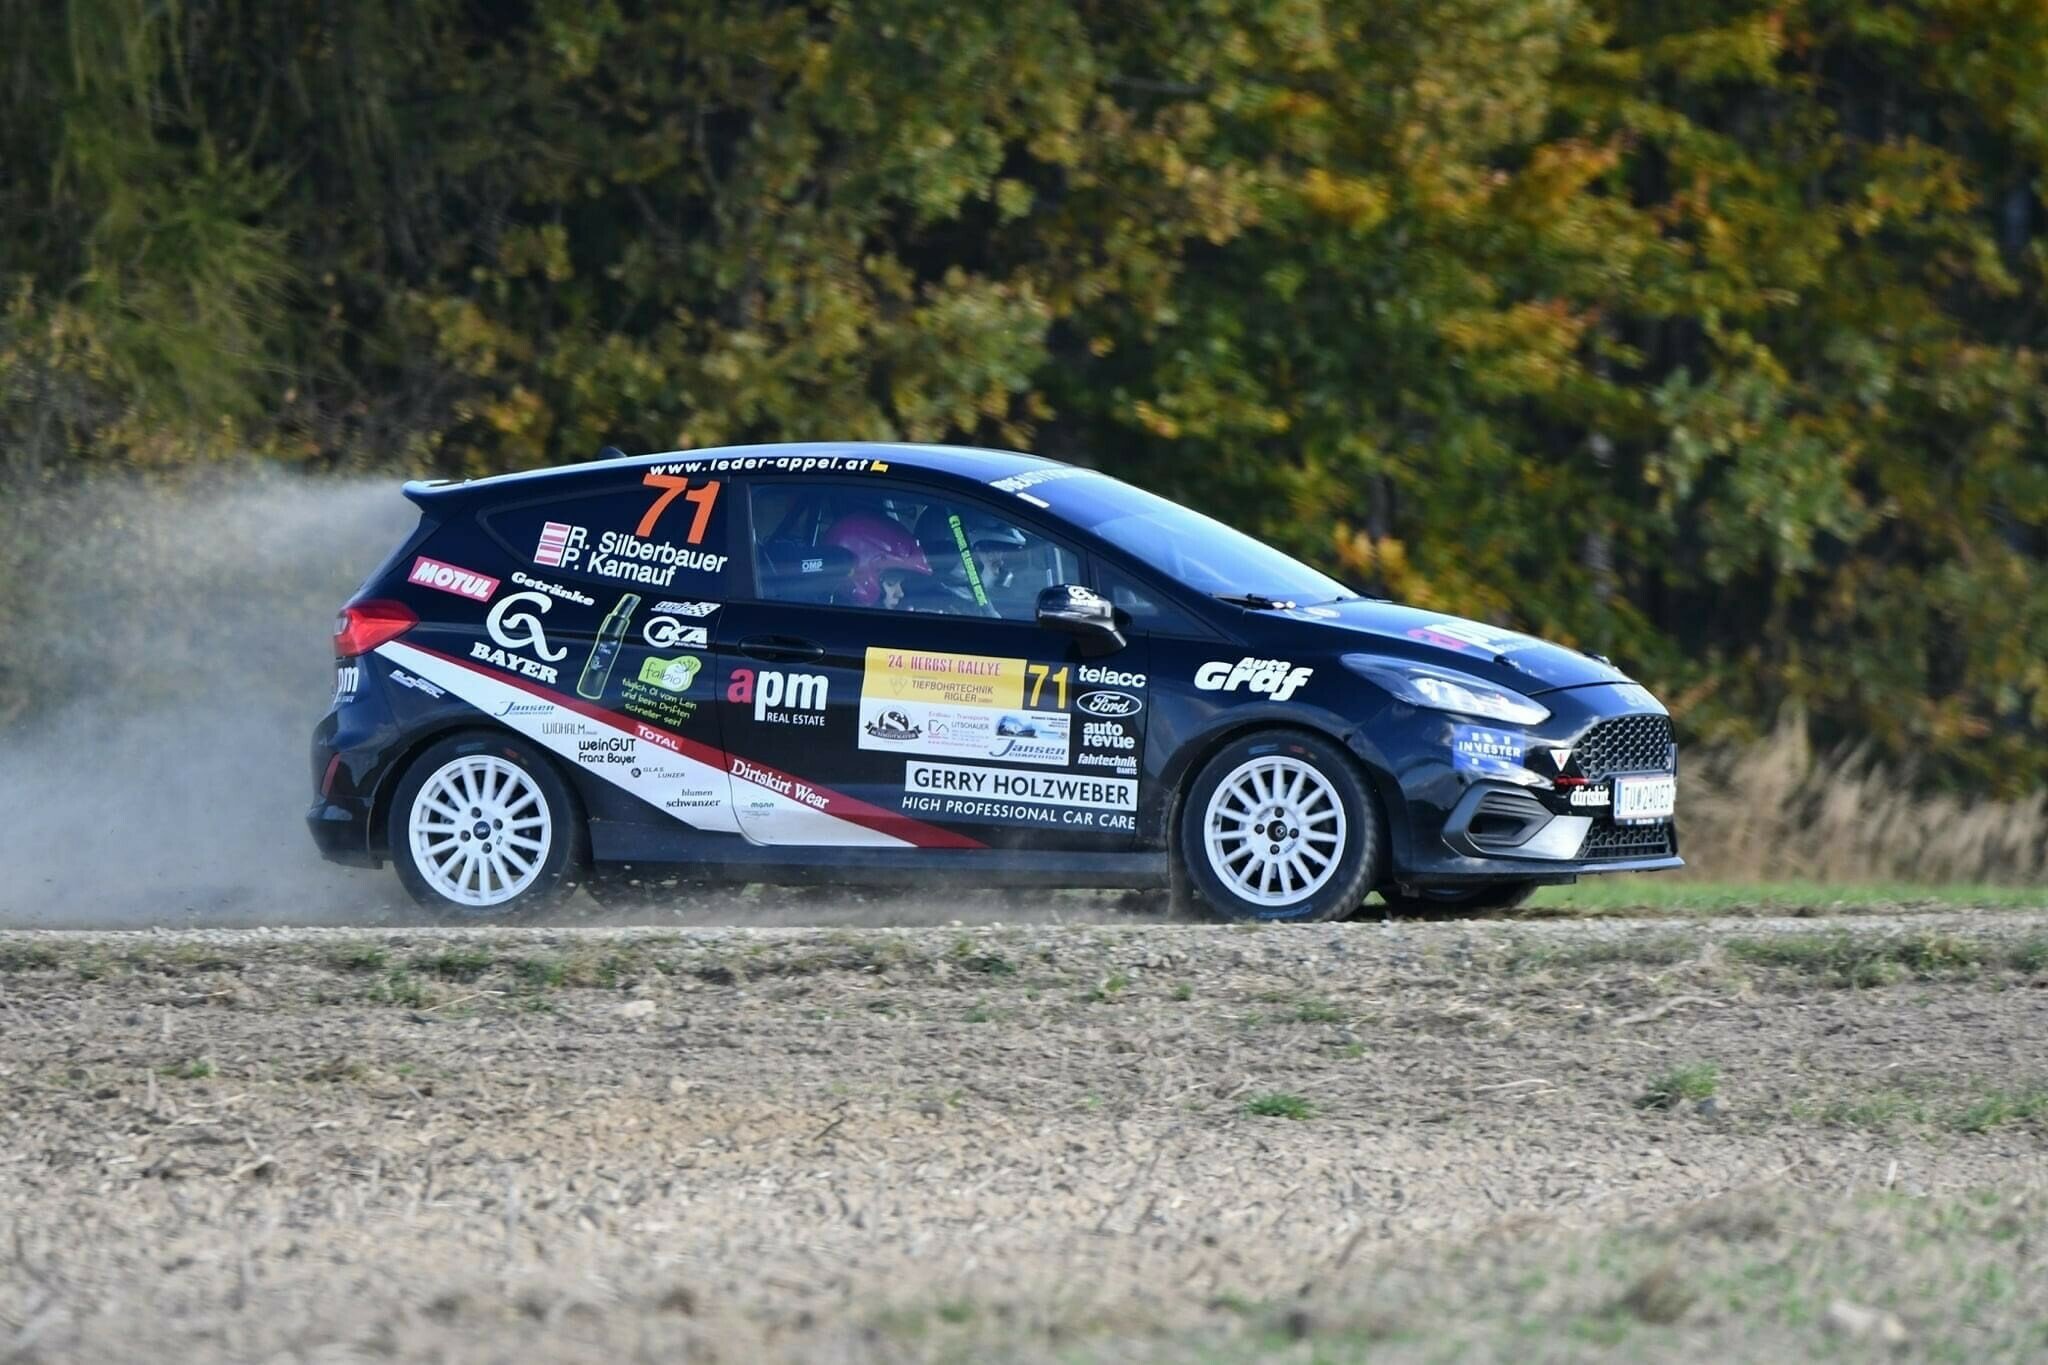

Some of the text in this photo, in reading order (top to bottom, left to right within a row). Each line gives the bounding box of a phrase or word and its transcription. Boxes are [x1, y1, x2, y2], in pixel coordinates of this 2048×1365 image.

[650, 457, 868, 475] www.leder-appel.at
[635, 473, 720, 544] 71
[560, 547, 580, 571] P.
[567, 526, 728, 573] R. Silberbauer
[802, 561, 823, 570] OMP
[413, 562, 491, 597] MOTUL
[511, 572, 595, 606] Getränke
[470, 642, 558, 684] BAYER
[911, 656, 953, 673] HERBST
[958, 660, 1001, 677] RALLYE
[336, 667, 359, 695] pm
[1028, 664, 1069, 709] 71
[1078, 665, 1147, 688] telacc
[1194, 661, 1314, 701] Graf
[727, 668, 829, 721] apm
[912, 679, 994, 695] TIEFBOHRTECHNIK
[621, 691, 637, 700] und
[659, 702, 690, 718] Driften
[944, 692, 977, 703] RIGLER
[1089, 694, 1130, 713] Ford
[494, 701, 554, 716] Jansen
[767, 711, 825, 726] REAL ESTATE
[542, 722, 586, 735] WIDHALM
[636, 724, 679, 750] TOTAL
[1083, 721, 1123, 735] auto
[578, 738, 636, 752] weinGUT
[989, 738, 1066, 757] Jansen
[1083, 734, 1135, 749] revue
[1459, 741, 1521, 758] INVESTER
[578, 753, 636, 766] Franz Bayer
[1078, 753, 1137, 768] fahrtechnik
[682, 789, 713, 797] blumen
[730, 759, 830, 809] Dirtskirt Wear
[914, 768, 1130, 805] GERRY HOLZWEBER
[666, 798, 720, 808] schwanzer
[902, 796, 1136, 830] HIGH PROFESSIONAL CAR CARE
